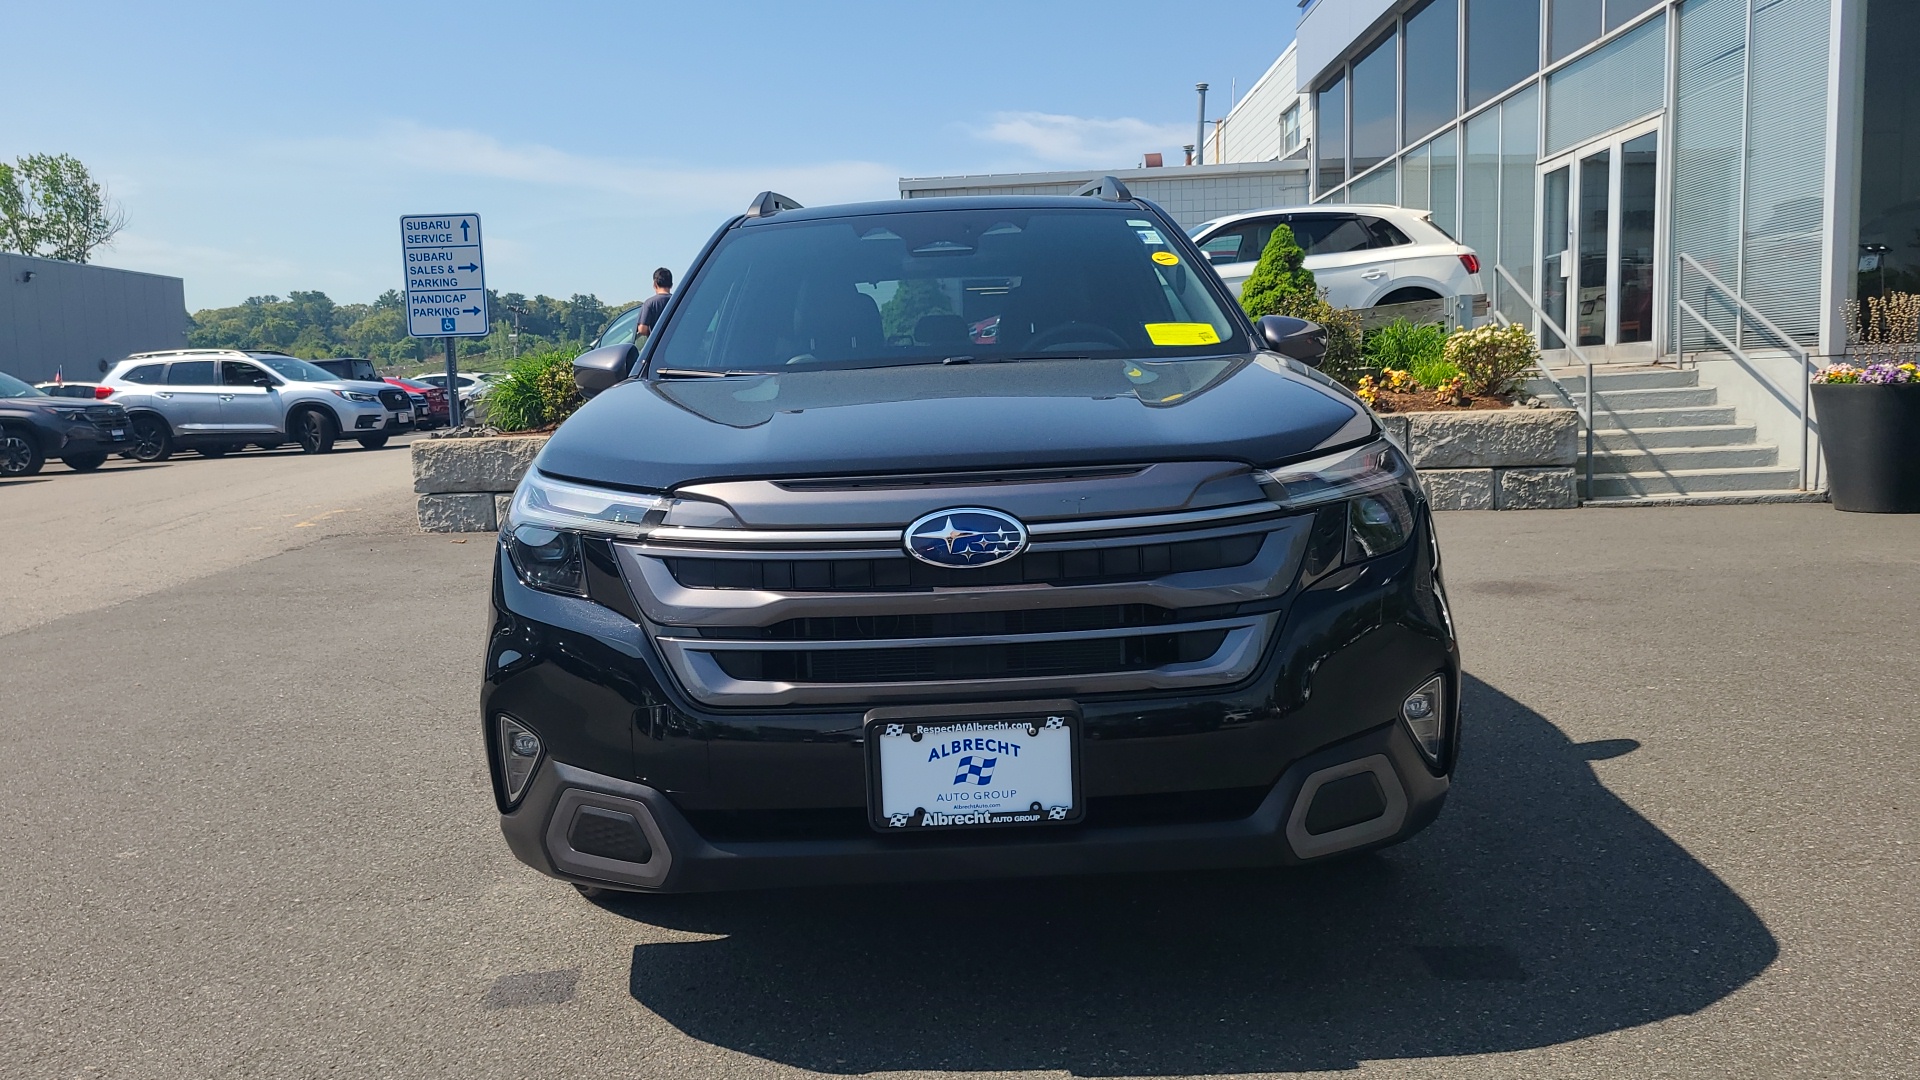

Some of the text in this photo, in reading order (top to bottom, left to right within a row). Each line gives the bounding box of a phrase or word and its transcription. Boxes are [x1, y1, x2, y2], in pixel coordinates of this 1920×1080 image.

[406, 220, 451, 231] SUBARU
[407, 233, 453, 244] SERVICE
[408, 252, 453, 263] SUBARU
[410, 265, 455, 275] SALES &
[411, 278, 458, 288] PARKING
[412, 294, 467, 304] HANDICAP
[413, 307, 460, 317] PARKING
[916, 722, 1032, 735] RespectAtAlbrecht.com
[928, 738, 1021, 762] ALBRECHT
[936, 789, 1017, 802] AUTO GROUP
[953, 802, 1001, 810] AlbrechtAuto.com
[921, 810, 1041, 827] Albrecht AUTO GROUP
